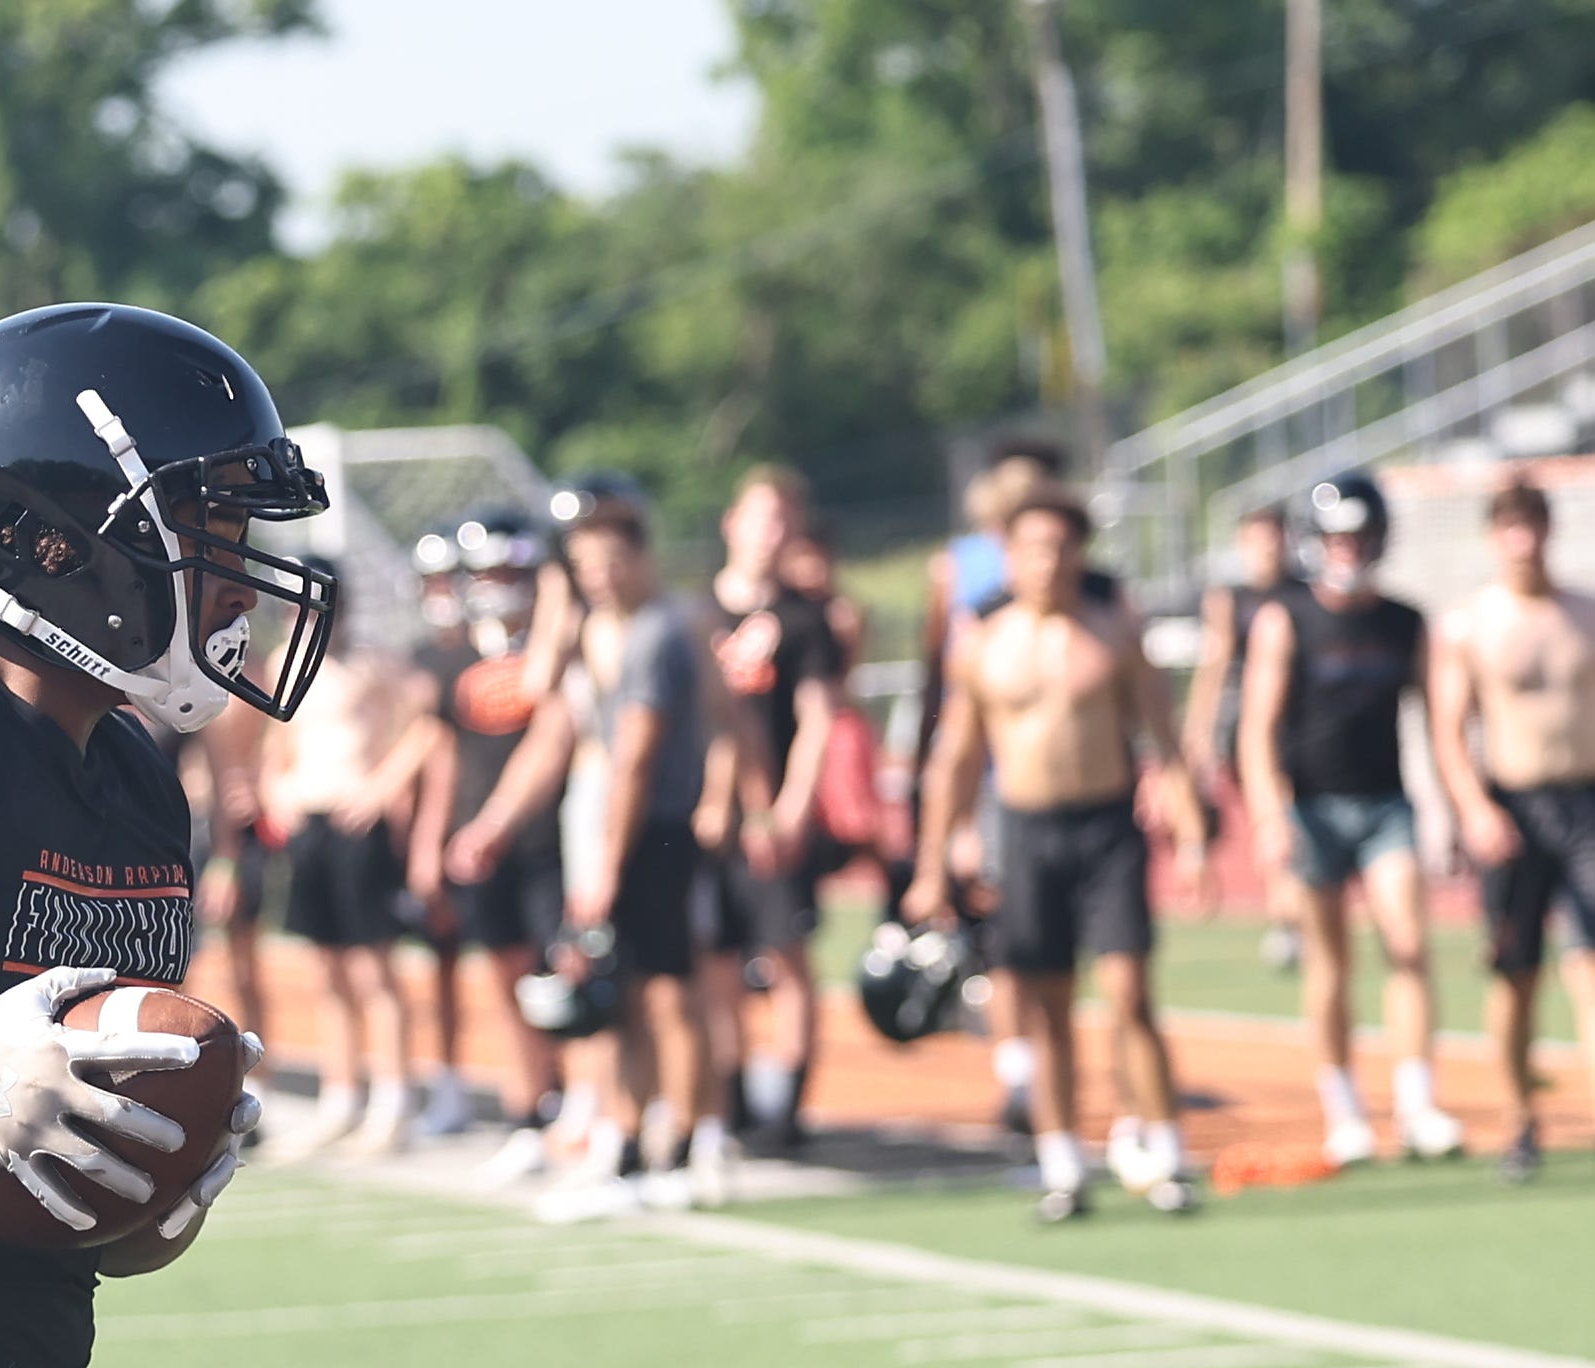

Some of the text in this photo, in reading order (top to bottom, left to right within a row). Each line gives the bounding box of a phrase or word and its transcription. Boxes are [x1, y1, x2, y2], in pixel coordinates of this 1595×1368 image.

[40, 849, 188, 886] ANDERSON RAPTOR
[5, 882, 194, 981] FOOTBA
